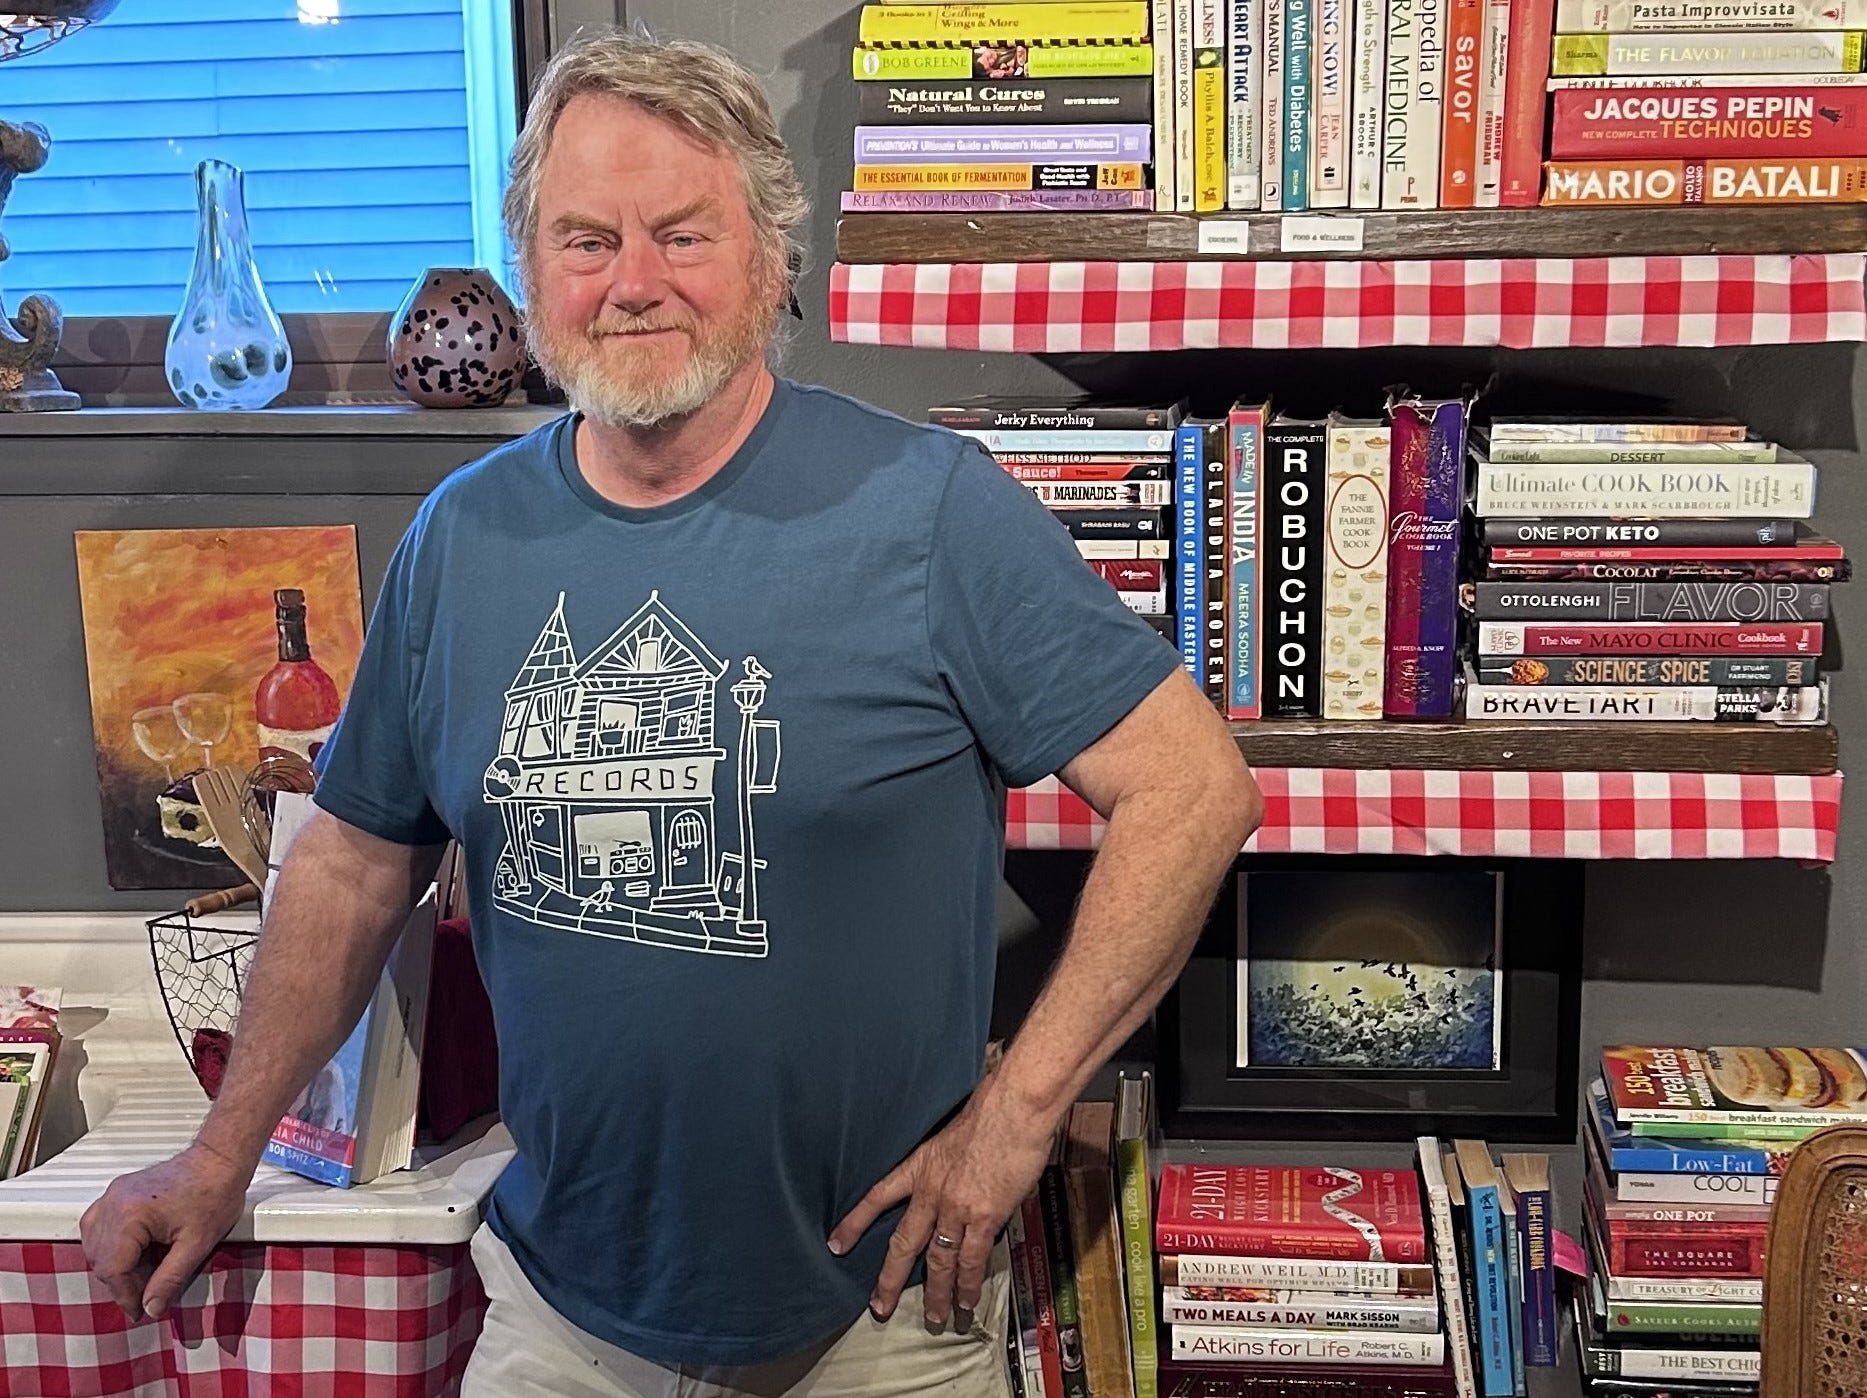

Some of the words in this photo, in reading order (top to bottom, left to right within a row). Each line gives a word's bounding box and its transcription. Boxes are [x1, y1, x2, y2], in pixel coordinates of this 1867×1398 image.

[1179, 5, 1188, 34] HOME
[1633, 4, 1676, 18] Pasta
[1681, 2, 1796, 19] Improvvisata
[942, 19, 973, 29] Wings
[977, 19, 986, 27] &
[989, 19, 1019, 28] More
[1291, 14, 1307, 51] Well
[1179, 38, 1188, 75] REMEDY
[1268, 14, 1279, 77] MANUAL
[1616, 48, 1650, 63] THE
[1659, 47, 1733, 63] FLAVOR
[882, 57, 910, 69] BOB
[914, 56, 968, 68] GREENE
[1233, 44, 1252, 103] ATTACK
[1291, 55, 1302, 80] with
[1323, 41, 1338, 97] NOW!
[1359, 39, 1377, 94] Strength
[1452, 36, 1475, 124] savor
[888, 87, 973, 102] Natural
[979, 87, 1046, 101] Cures
[1180, 79, 1189, 107] BOOK
[1204, 72, 1215, 111] Phyllis
[1418, 81, 1441, 105] of
[1268, 97, 1278, 116] TED
[1386, 54, 1410, 174] MEDICINE
[1583, 97, 1718, 120] JACQUES
[1727, 97, 1814, 119] PEPIN
[1289, 85, 1304, 152] Diabetes
[1331, 114, 1341, 140] JEAN
[1367, 107, 1377, 144] ARTHUR
[1660, 120, 1813, 139] TECHNIQUES
[1030, 139, 1058, 150] Health
[1074, 138, 1114, 149] Wellness
[1268, 118, 1278, 166] ANDREWS
[1319, 114, 1330, 159] CARPER
[1357, 113, 1366, 156] BROOKS
[1483, 110, 1494, 166] FRIEDMAN
[1493, 116, 1503, 161] ANDREW
[1582, 131, 1604, 139] NEW
[1605, 131, 1659, 139] COMPLETE
[1368, 147, 1375, 158] C
[863, 172, 877, 183] THE
[881, 172, 923, 183] ESSENTIAL
[927, 171, 948, 182] BOOK
[952, 172, 961, 182] OF
[965, 172, 1027, 182] FERMENTATION
[1549, 169, 1676, 200] MARIO
[1712, 165, 1840, 198] BATALI
[1684, 165, 1694, 202] MOLTO
[994, 413, 1028, 427] Jerky
[1030, 413, 1095, 427] Everything
[1183, 436, 1195, 460] THE
[1240, 431, 1256, 469] MADE
[1267, 435, 1282, 443] THE
[1282, 435, 1324, 443] COMPLETE
[1610, 452, 1666, 463] DESSERT
[1012, 466, 1062, 479] Sauce!
[1183, 466, 1195, 494] NEW
[1490, 472, 1576, 493] Ultimate
[1582, 473, 1651, 493] COOK
[1661, 473, 1730, 493] BOOK
[1053, 486, 1117, 500] MARINADES
[1349, 493, 1368, 502] THE
[1341, 506, 1375, 514] FANNIE
[1489, 501, 1526, 509] BRUCE
[1531, 501, 1597, 509] WEINSTEIN
[1614, 501, 1647, 509] MARK
[1183, 500, 1196, 535] BOOK
[1208, 461, 1224, 579] CLAUDIA
[1232, 490, 1256, 565] INDIA
[1338, 517, 1376, 526] FARMER
[1391, 511, 1460, 545] Gourmet
[1518, 526, 1558, 540] ONE
[1563, 526, 1602, 540] POT
[1605, 525, 1660, 540] KETO
[1183, 540, 1196, 557] OF
[1343, 540, 1370, 549] BOOK
[1277, 448, 1309, 698] ROBUCHON
[1593, 565, 1661, 578] COCOLAT
[1183, 562, 1196, 610] MIDDLE
[1238, 582, 1249, 629] MEERA
[1500, 595, 1600, 607] OTTOLENGHI
[1608, 583, 1803, 620] FLAVOR
[1183, 615, 1196, 672] EASTERN
[1208, 601, 1224, 684] RODEN
[1539, 636, 1557, 646] The
[1560, 636, 1583, 646] New
[1589, 633, 1655, 648] MAYO
[1657, 633, 1733, 648] CLINIC
[1737, 633, 1787, 643] Cookbook
[1237, 631, 1249, 678] SODHA
[1574, 661, 1648, 683] SCIENCE
[1660, 661, 1711, 683] SPICE
[1483, 691, 1660, 714] BRAVETART
[1717, 693, 1761, 703] STELLA
[1719, 704, 1757, 714] PARKS
[525, 765, 699, 794] RECORDS
[1624, 1074, 1655, 1096] 150
[1645, 1047, 1693, 1107] breakfast
[1688, 1112, 1707, 1121] 150
[1728, 1112, 1777, 1123] breakfast
[1779, 1113, 1827, 1124] sandwich
[268, 1143, 286, 1157] BOB
[292, 1131, 323, 1151] CHILD
[1672, 1153, 1754, 1173] Low-Fat
[1190, 1166, 1227, 1220] 21-DAY
[1254, 1167, 1270, 1222] KICKSTART
[1694, 1175, 1755, 1192] COOL
[1122, 1187, 1142, 1230] garten
[1653, 1210, 1684, 1221] ONE
[1686, 1210, 1716, 1221] POT
[1163, 1233, 1216, 1248] 21-DAY
[1130, 1241, 1144, 1273] cook
[1677, 1251, 1733, 1259] SQUARE
[1180, 1262, 1253, 1275] ANDREW
[1318, 1266, 1349, 1278] M.D.
[1639, 1285, 1693, 1295] TREASURY
[1133, 1309, 1147, 1332] pro
[1173, 1308, 1208, 1321] TWO
[1212, 1309, 1266, 1323] MEALS
[1270, 1311, 1281, 1323] A
[1285, 1311, 1316, 1325] DAY
[1326, 1310, 1358, 1321] MARK
[1360, 1311, 1400, 1322] SISSON
[1634, 1316, 1678, 1325] SAVEUR
[1683, 1316, 1722, 1326] COOKS
[1191, 1337, 1264, 1356] Atkins
[1268, 1337, 1302, 1357] for
[1306, 1339, 1351, 1358] Life
[1356, 1350, 1389, 1360] Atkins,
[1361, 1341, 1395, 1350] Robert
[1397, 1342, 1409, 1351] C.
[1659, 1355, 1689, 1368] THE
[1691, 1357, 1726, 1369] BEST
